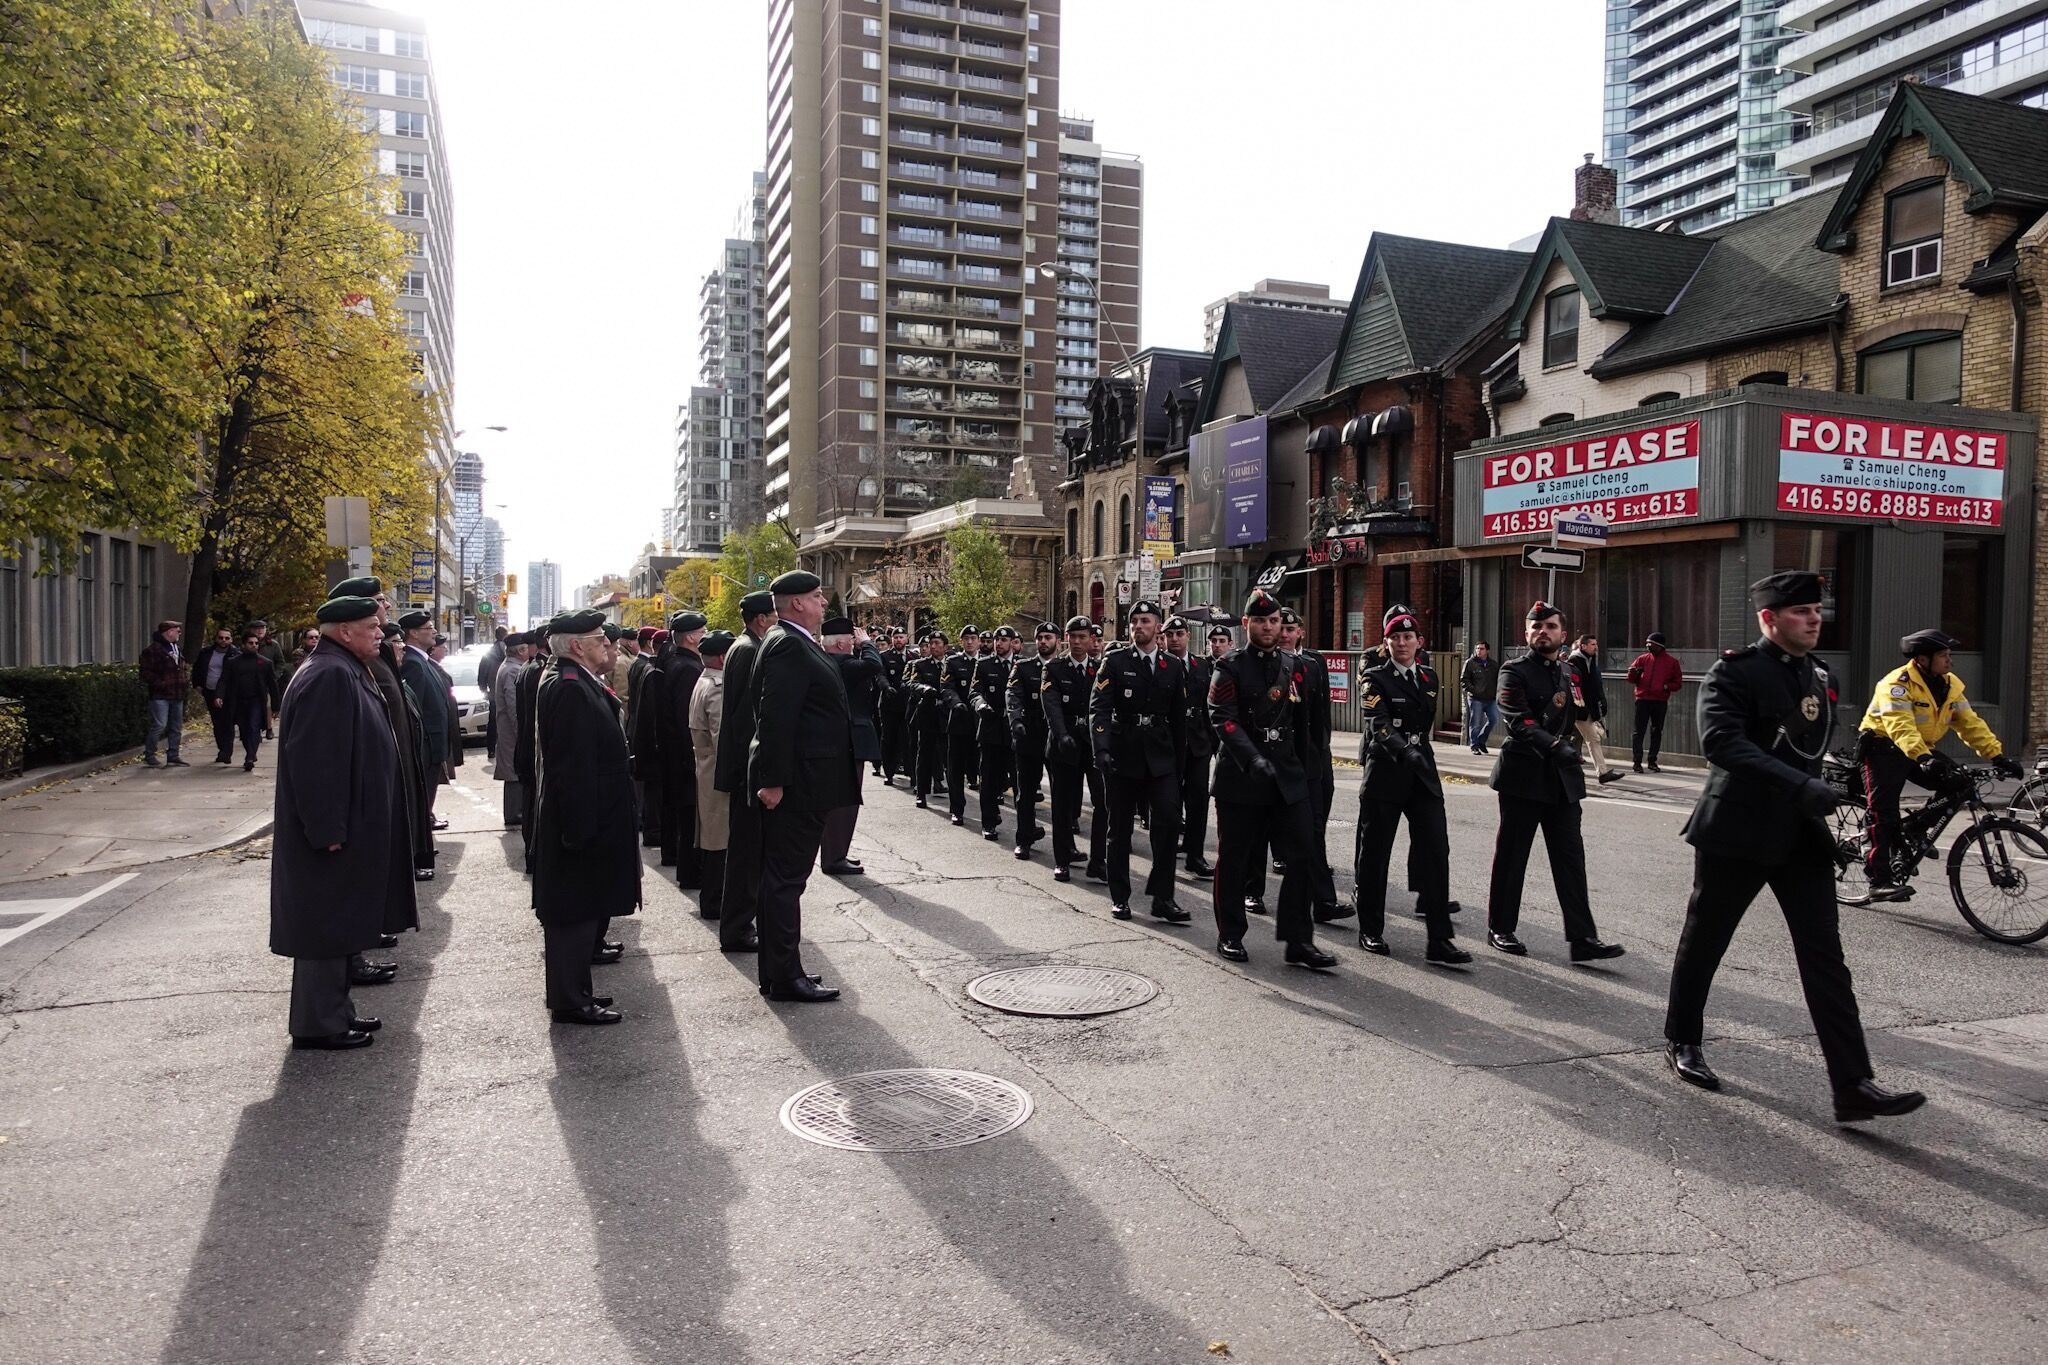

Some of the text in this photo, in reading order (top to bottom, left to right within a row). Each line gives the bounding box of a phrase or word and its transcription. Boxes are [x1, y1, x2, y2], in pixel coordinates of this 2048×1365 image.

[1789, 417, 1997, 467] FOR LEASE
[1492, 426, 1688, 486] FOR LEASE
[1859, 459, 1947, 481] Samuel Cheng
[1549, 471, 1629, 492] Samuel Cheng
[1820, 472, 1966, 495] samuelc@shiupong.com
[1520, 482, 1649, 509] samuelc@shiupong.com
[1623, 501, 1646, 517] Ext
[1649, 492, 1686, 514] 613
[1786, 486, 1993, 520] 416.596.8885 Ext 613
[1158, 513, 1169, 522] THE
[1158, 522, 1172, 532] LAST
[1158, 531, 1172, 541] SHIP
[1565, 523, 1601, 536] Hayden St
[1257, 565, 1287, 585] 638
[1326, 659, 1346, 670] EASE
[1927, 797, 1948, 810] POLICE
[1927, 815, 1947, 841] TORONTO
